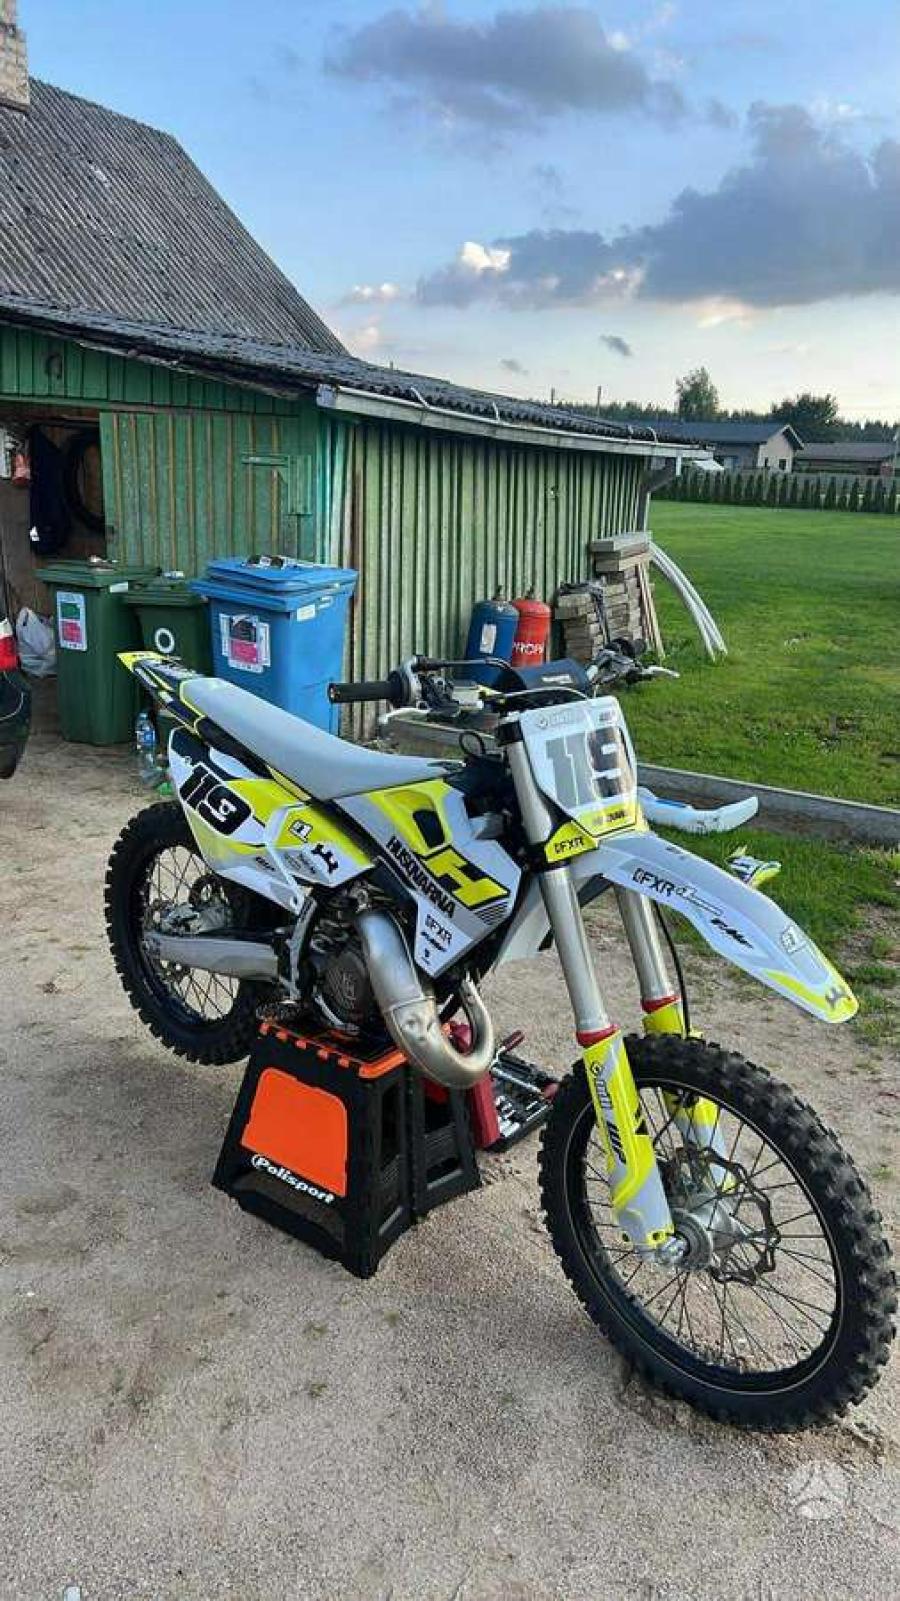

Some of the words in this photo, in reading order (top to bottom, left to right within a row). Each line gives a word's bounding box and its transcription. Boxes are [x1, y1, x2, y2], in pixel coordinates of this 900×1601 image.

[180, 763, 252, 835] 119
[385, 835, 456, 919] HUSQVARNA
[252, 1155, 336, 1205] Polisport
